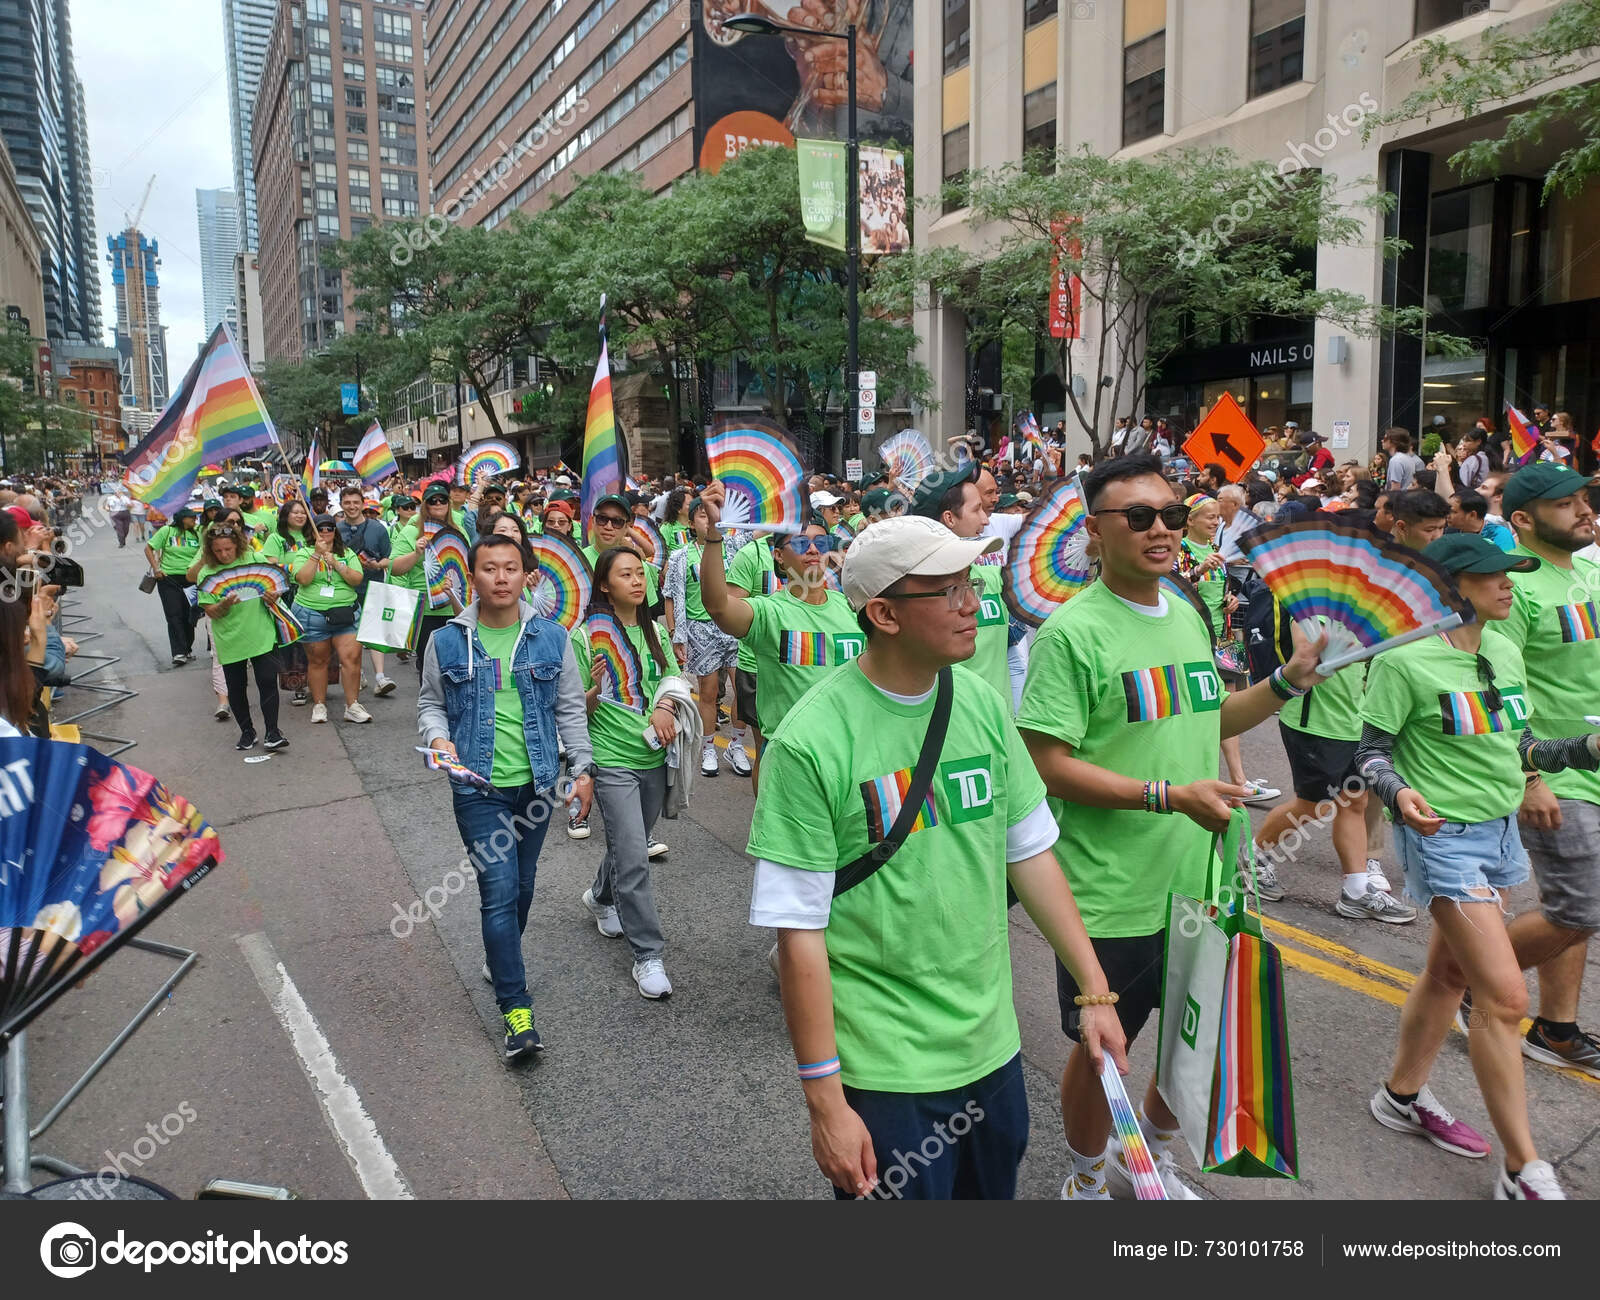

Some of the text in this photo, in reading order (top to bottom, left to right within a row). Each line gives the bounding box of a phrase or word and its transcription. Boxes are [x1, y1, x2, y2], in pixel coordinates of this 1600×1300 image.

[1250, 344, 1313, 367] NAILS O
[414, 448, 426, 457] 40
[836, 638, 863, 660] TD
[1189, 670, 1219, 701] TD
[948, 767, 993, 809] TD
